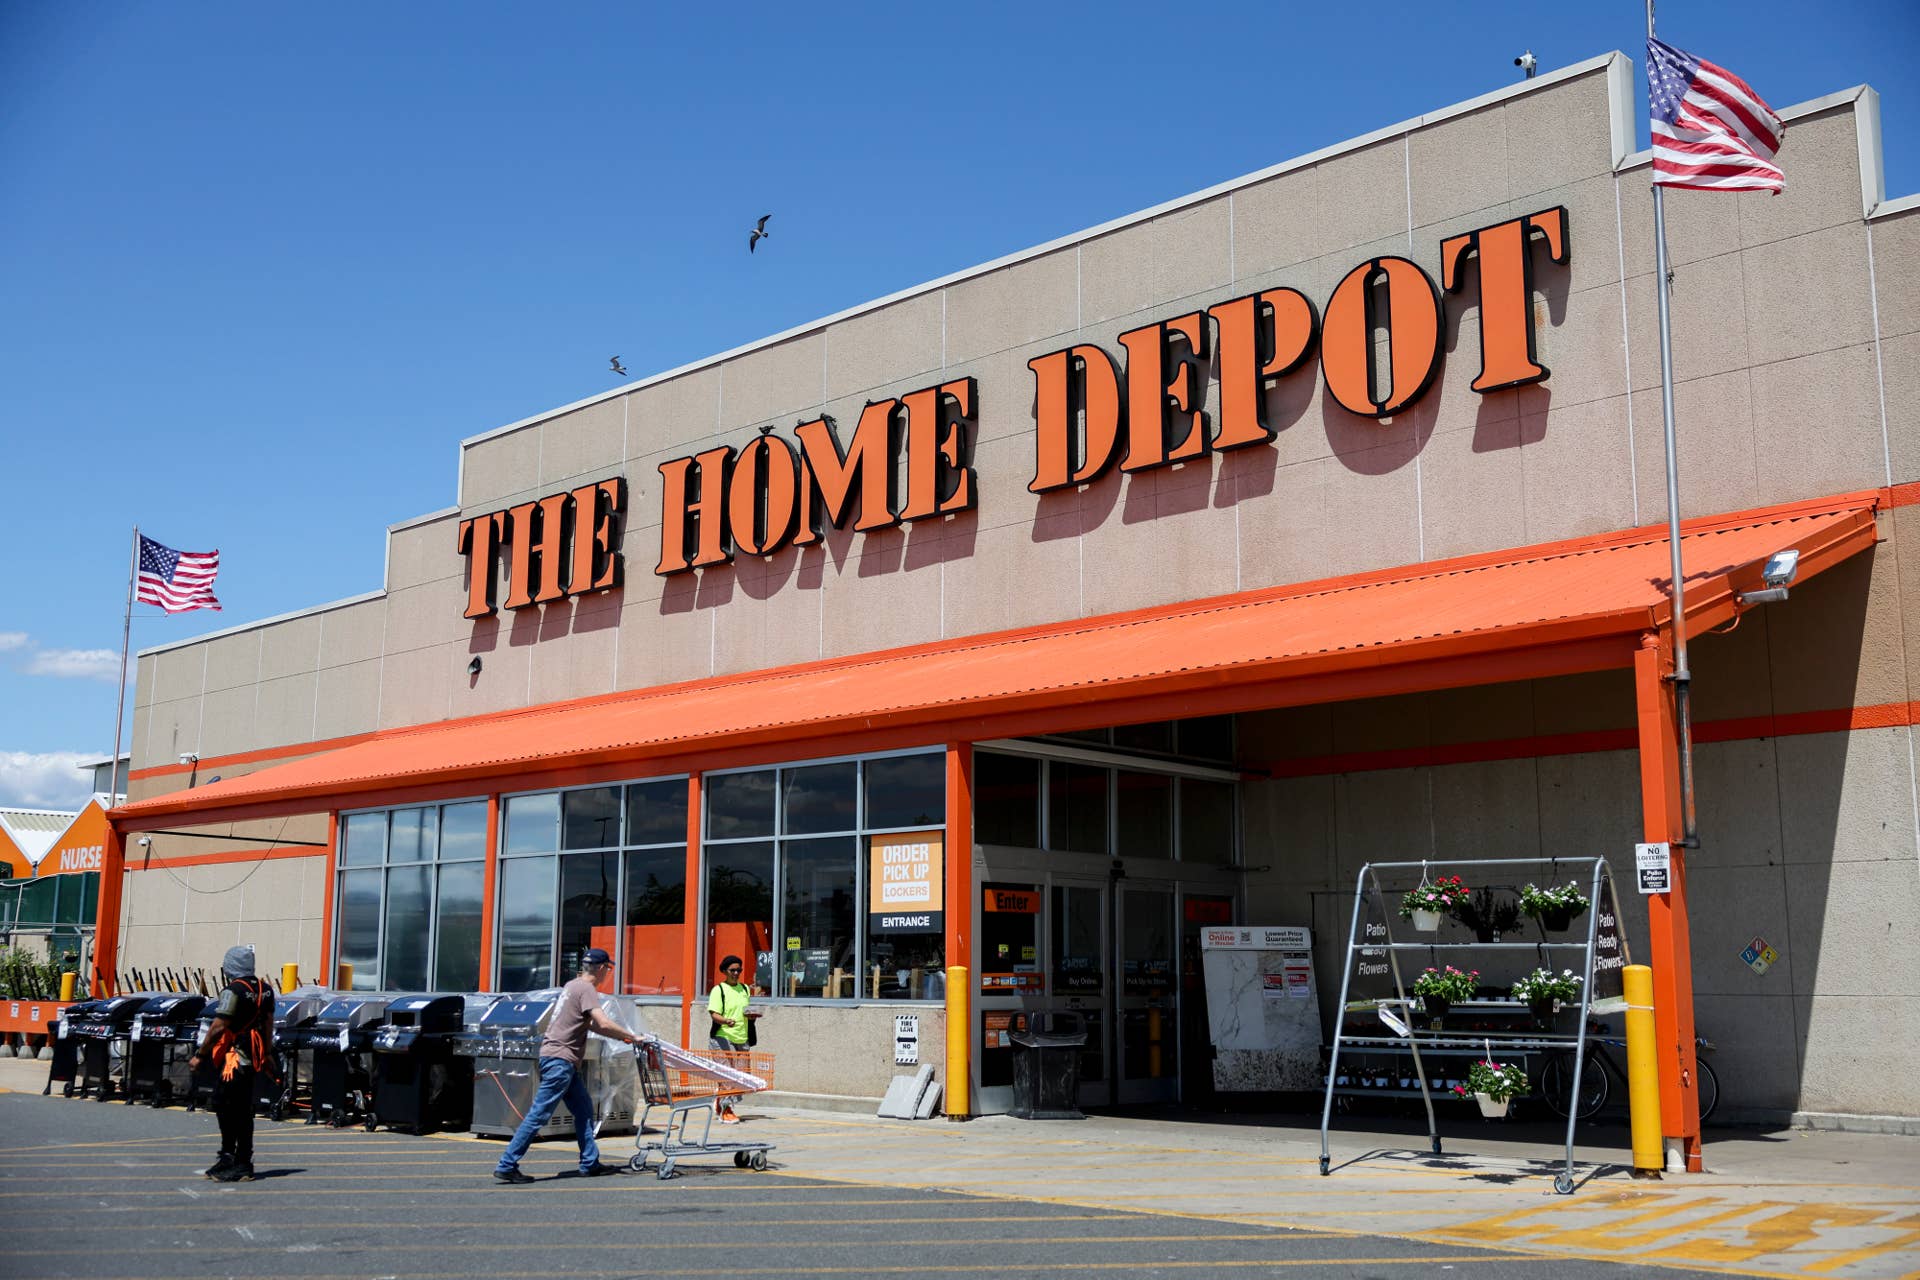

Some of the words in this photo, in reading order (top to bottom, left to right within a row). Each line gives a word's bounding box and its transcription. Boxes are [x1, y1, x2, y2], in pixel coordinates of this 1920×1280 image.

[458, 476, 626, 619] THE
[654, 376, 977, 577] HOME
[1027, 205, 1570, 494] DEPOT
[60, 845, 103, 870] NURSE
[883, 843, 929, 864] ORDER
[883, 864, 910, 881] PICK
[913, 863, 929, 879] UP
[885, 886, 928, 897] LOCKERS
[996, 892, 1029, 911] Enter
[882, 916, 930, 928] ENTRANCE
[1599, 913, 1615, 928] Patio
[1366, 923, 1386, 936] Patio
[1208, 934, 1235, 942] Online
[1598, 933, 1617, 949] Ready
[1358, 962, 1389, 975] Flowers
[1597, 956, 1621, 970] Flowers
[1069, 977, 1079, 986] Buy
